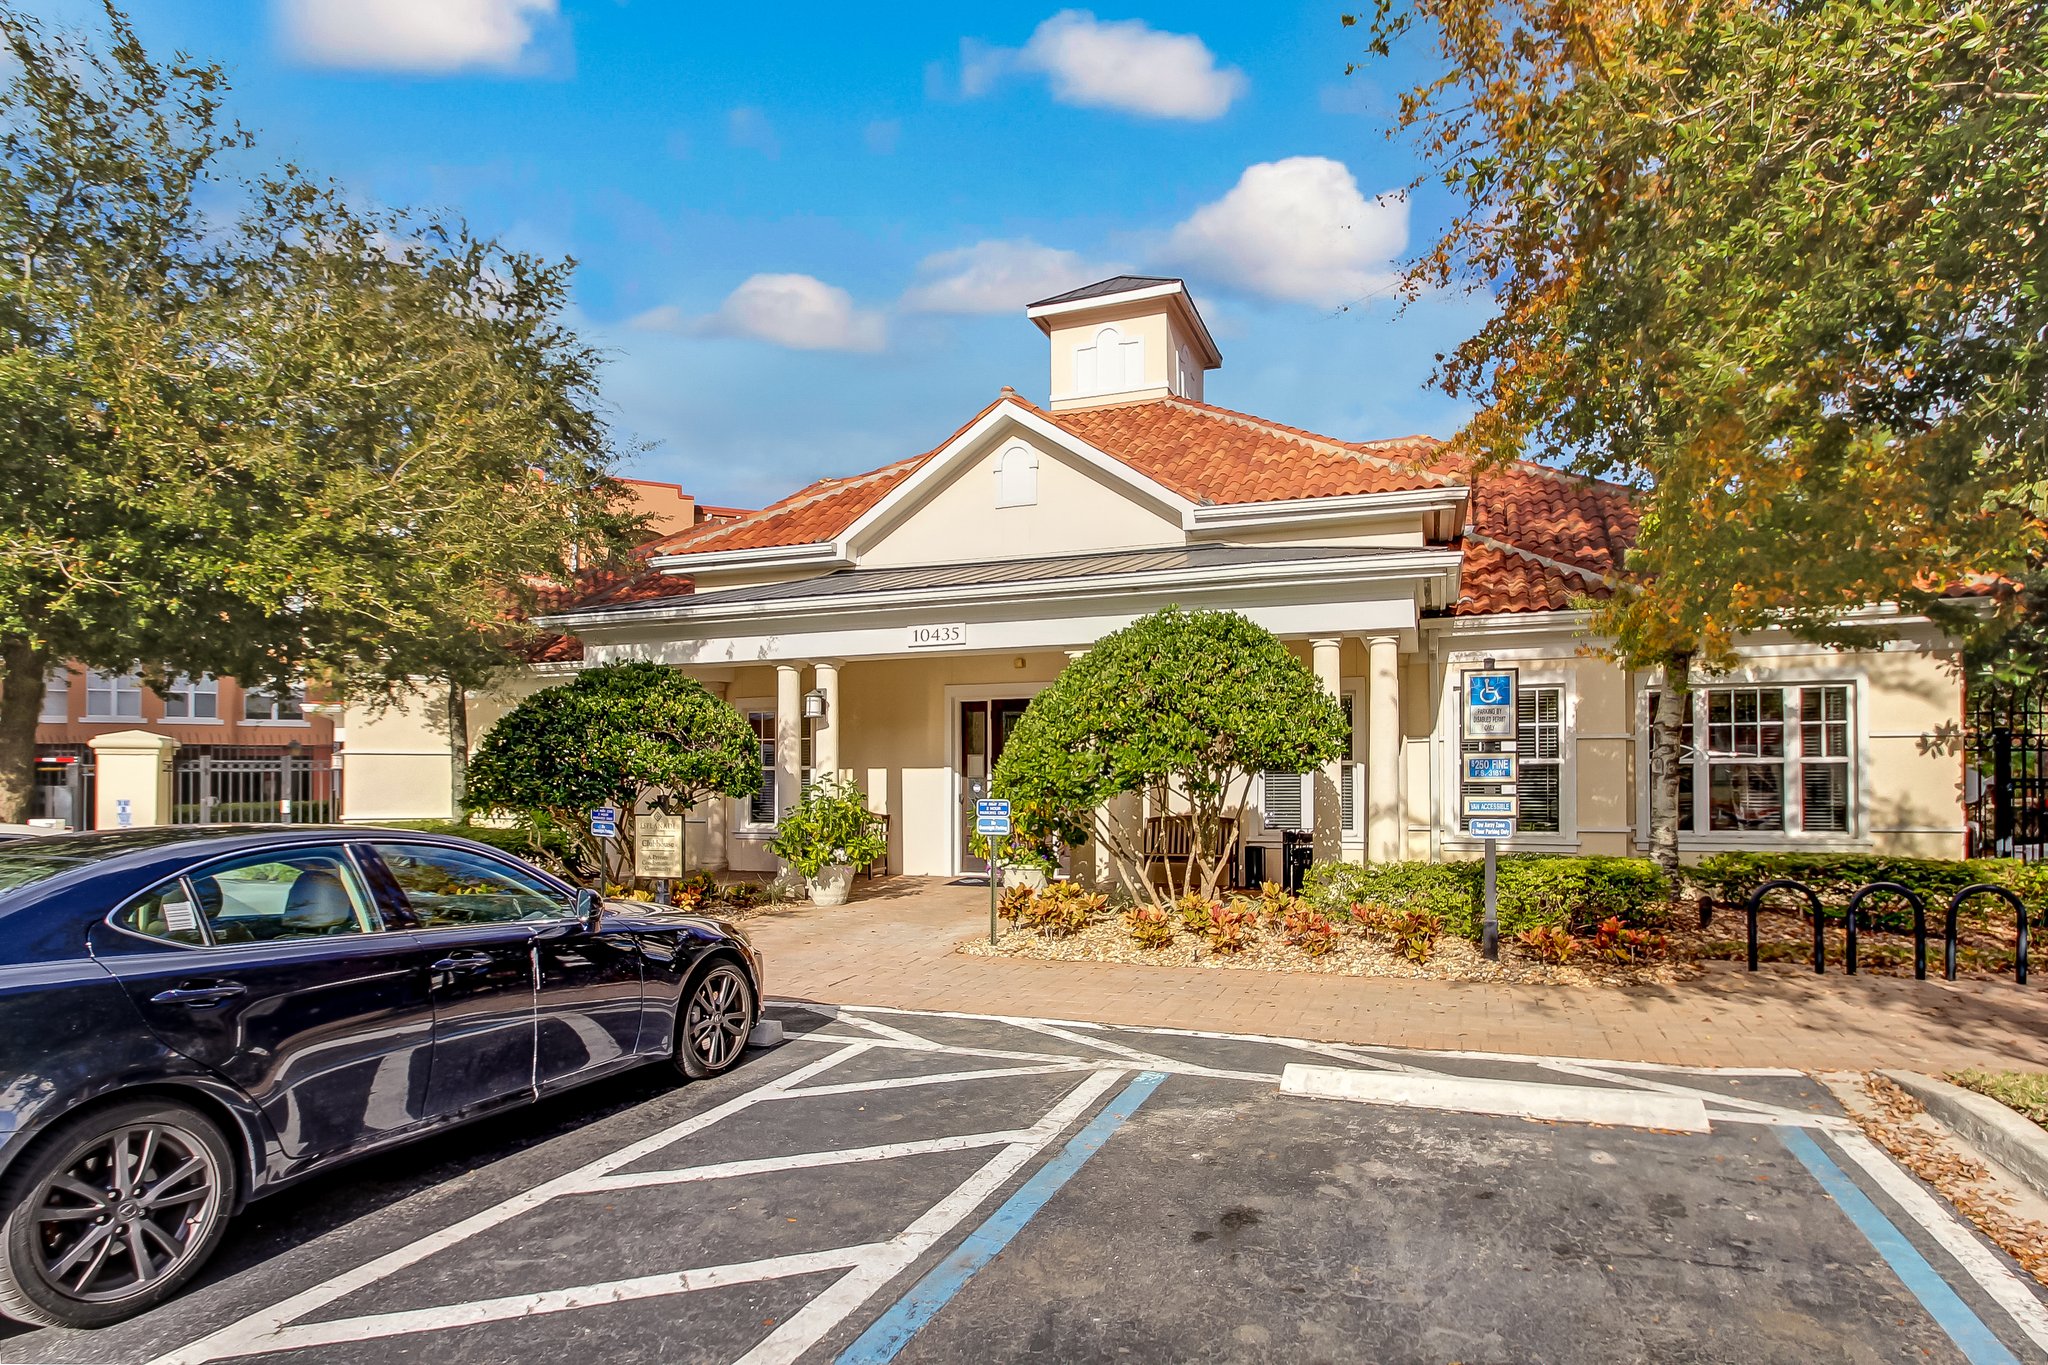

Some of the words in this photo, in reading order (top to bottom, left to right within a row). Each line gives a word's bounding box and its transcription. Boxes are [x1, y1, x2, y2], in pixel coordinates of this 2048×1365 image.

[913, 627, 960, 642] 10435
[1471, 760, 1489, 769] $250
[1492, 760, 1509, 769] FINE
